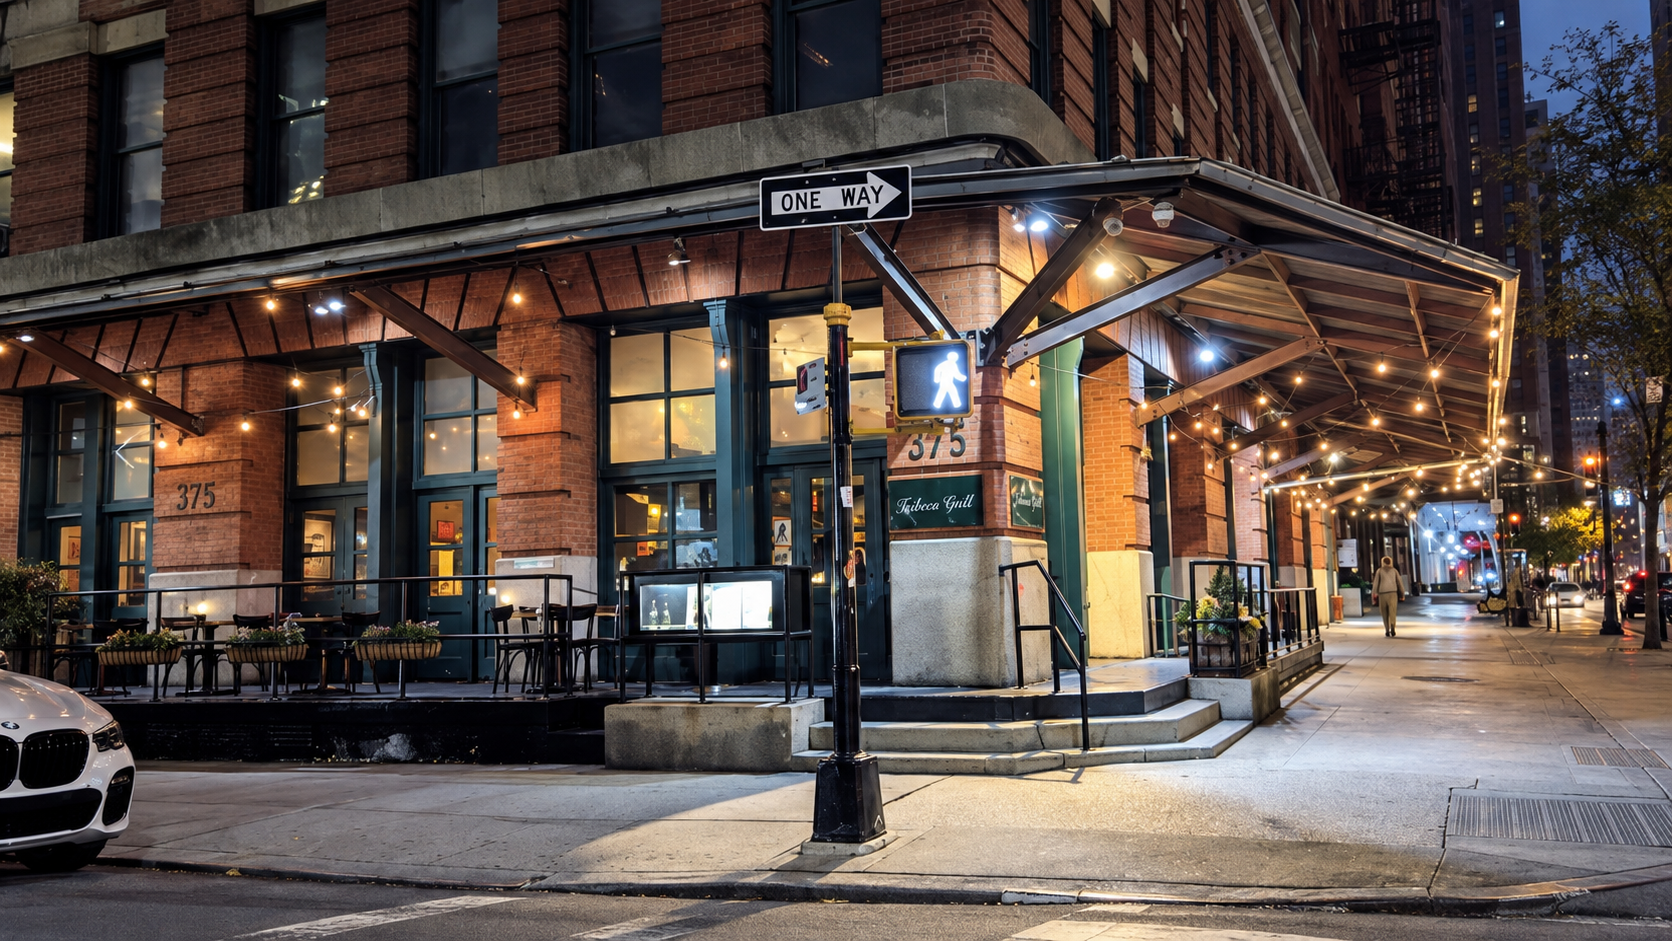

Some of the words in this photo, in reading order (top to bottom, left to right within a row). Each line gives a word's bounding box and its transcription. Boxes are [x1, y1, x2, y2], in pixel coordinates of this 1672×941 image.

[781, 191, 822, 212] ONE
[841, 185, 884, 207] WAY
[176, 481, 216, 511] 375
[895, 497, 940, 515] Tribeca
[942, 493, 975, 515] Grill
